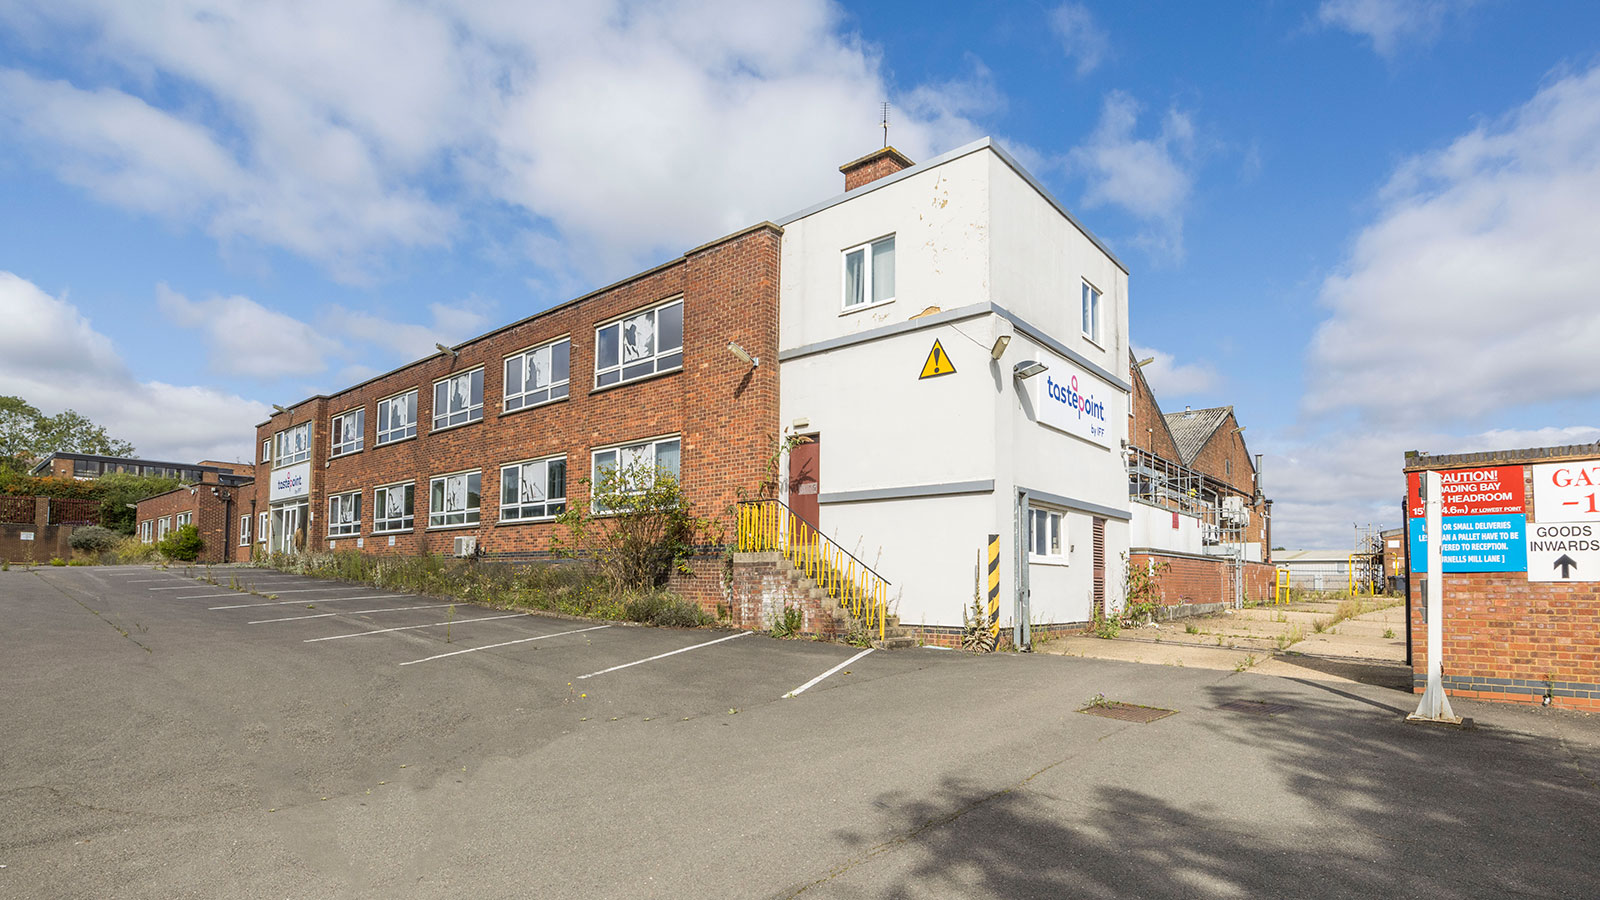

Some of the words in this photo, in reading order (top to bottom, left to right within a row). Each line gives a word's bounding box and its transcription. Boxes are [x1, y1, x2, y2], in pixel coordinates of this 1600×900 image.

[1047, 374, 1104, 421] tastepoint
[1090, 424, 1096, 437] by
[1097, 426, 1105, 437] IFF
[1441, 470, 1498, 483] AUTION!
[1441, 484, 1478, 493] ADING
[1480, 482, 1501, 491] BAY
[1447, 492, 1513, 503] HEADROOM
[1441, 505, 1469, 515] 4.6m)
[1442, 523, 1452, 531] OR
[1453, 522, 1474, 531] SMALL
[1475, 521, 1511, 530] DELIVERIES
[1536, 525, 1592, 538] GOODS
[1452, 533, 1457, 541] A
[1458, 532, 1480, 541] PALLET
[1481, 532, 1498, 540] HAVE
[1499, 532, 1509, 540] TO
[1510, 531, 1519, 540] BE
[1461, 543, 1470, 551] TO
[1471, 542, 1509, 551] RECEPTION.
[1530, 539, 1600, 552] INWARDS
[1468, 555, 1483, 563] MILL
[1483, 554, 1501, 562] LANE
